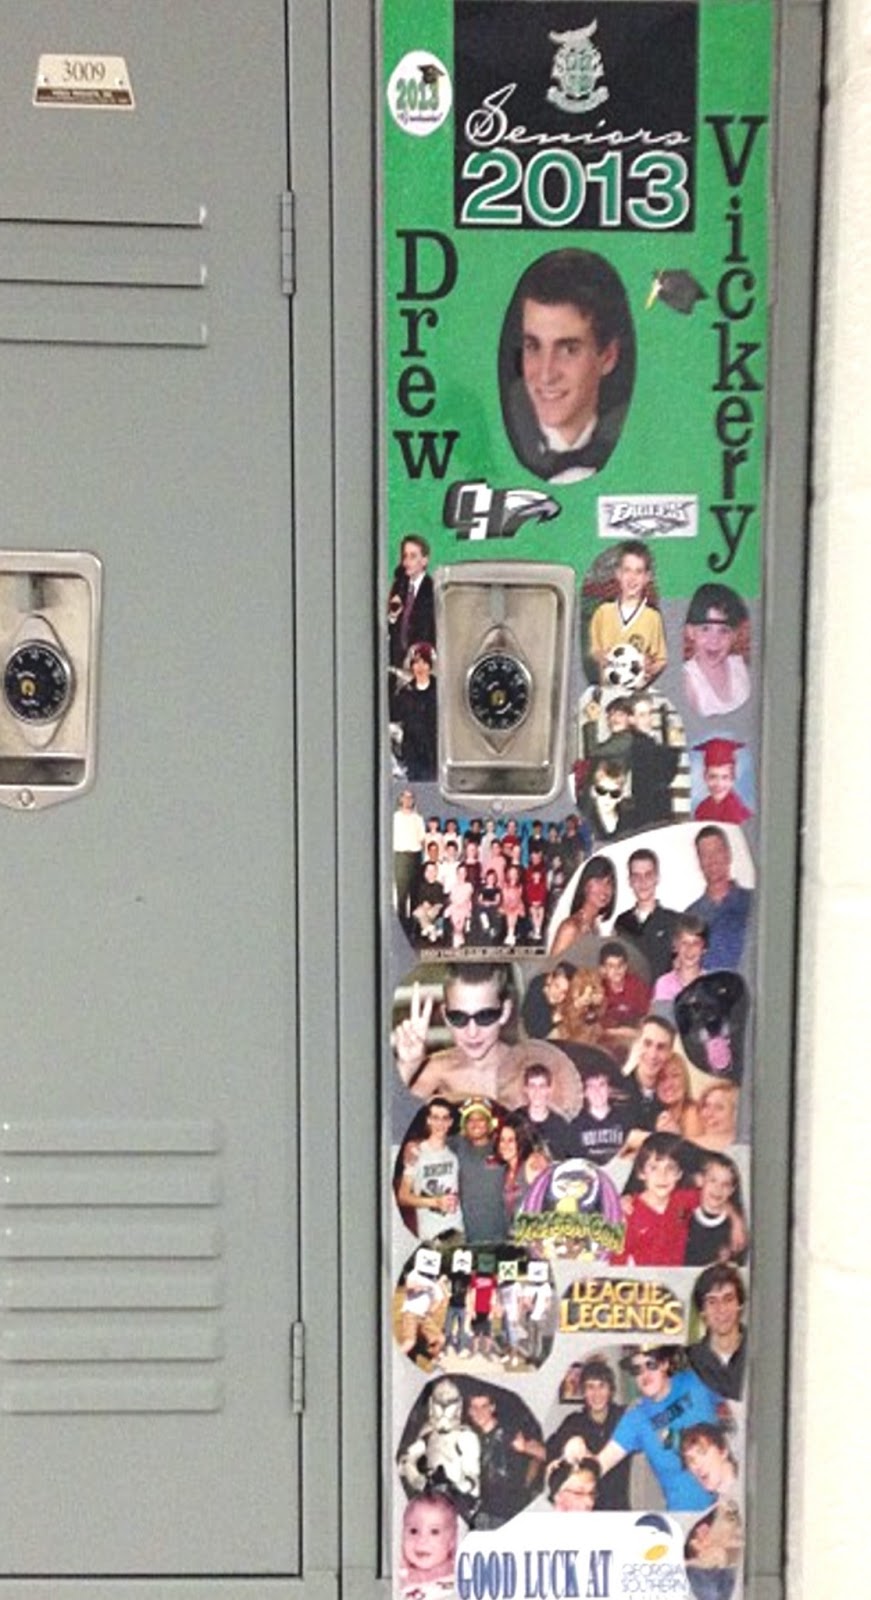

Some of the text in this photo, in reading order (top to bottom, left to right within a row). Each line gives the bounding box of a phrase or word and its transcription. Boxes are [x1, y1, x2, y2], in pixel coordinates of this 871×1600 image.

[63, 60, 106, 81] 3009
[465, 83, 691, 147] Seniors
[460, 148, 691, 229] 2013
[393, 229, 460, 480] Drew
[705, 114, 768, 573] Vickery
[559, 1299, 683, 1335] LEGENDS
[571, 1280, 664, 1304] LEAGUE
[457, 1549, 614, 1600] GOOD LUCK AT
